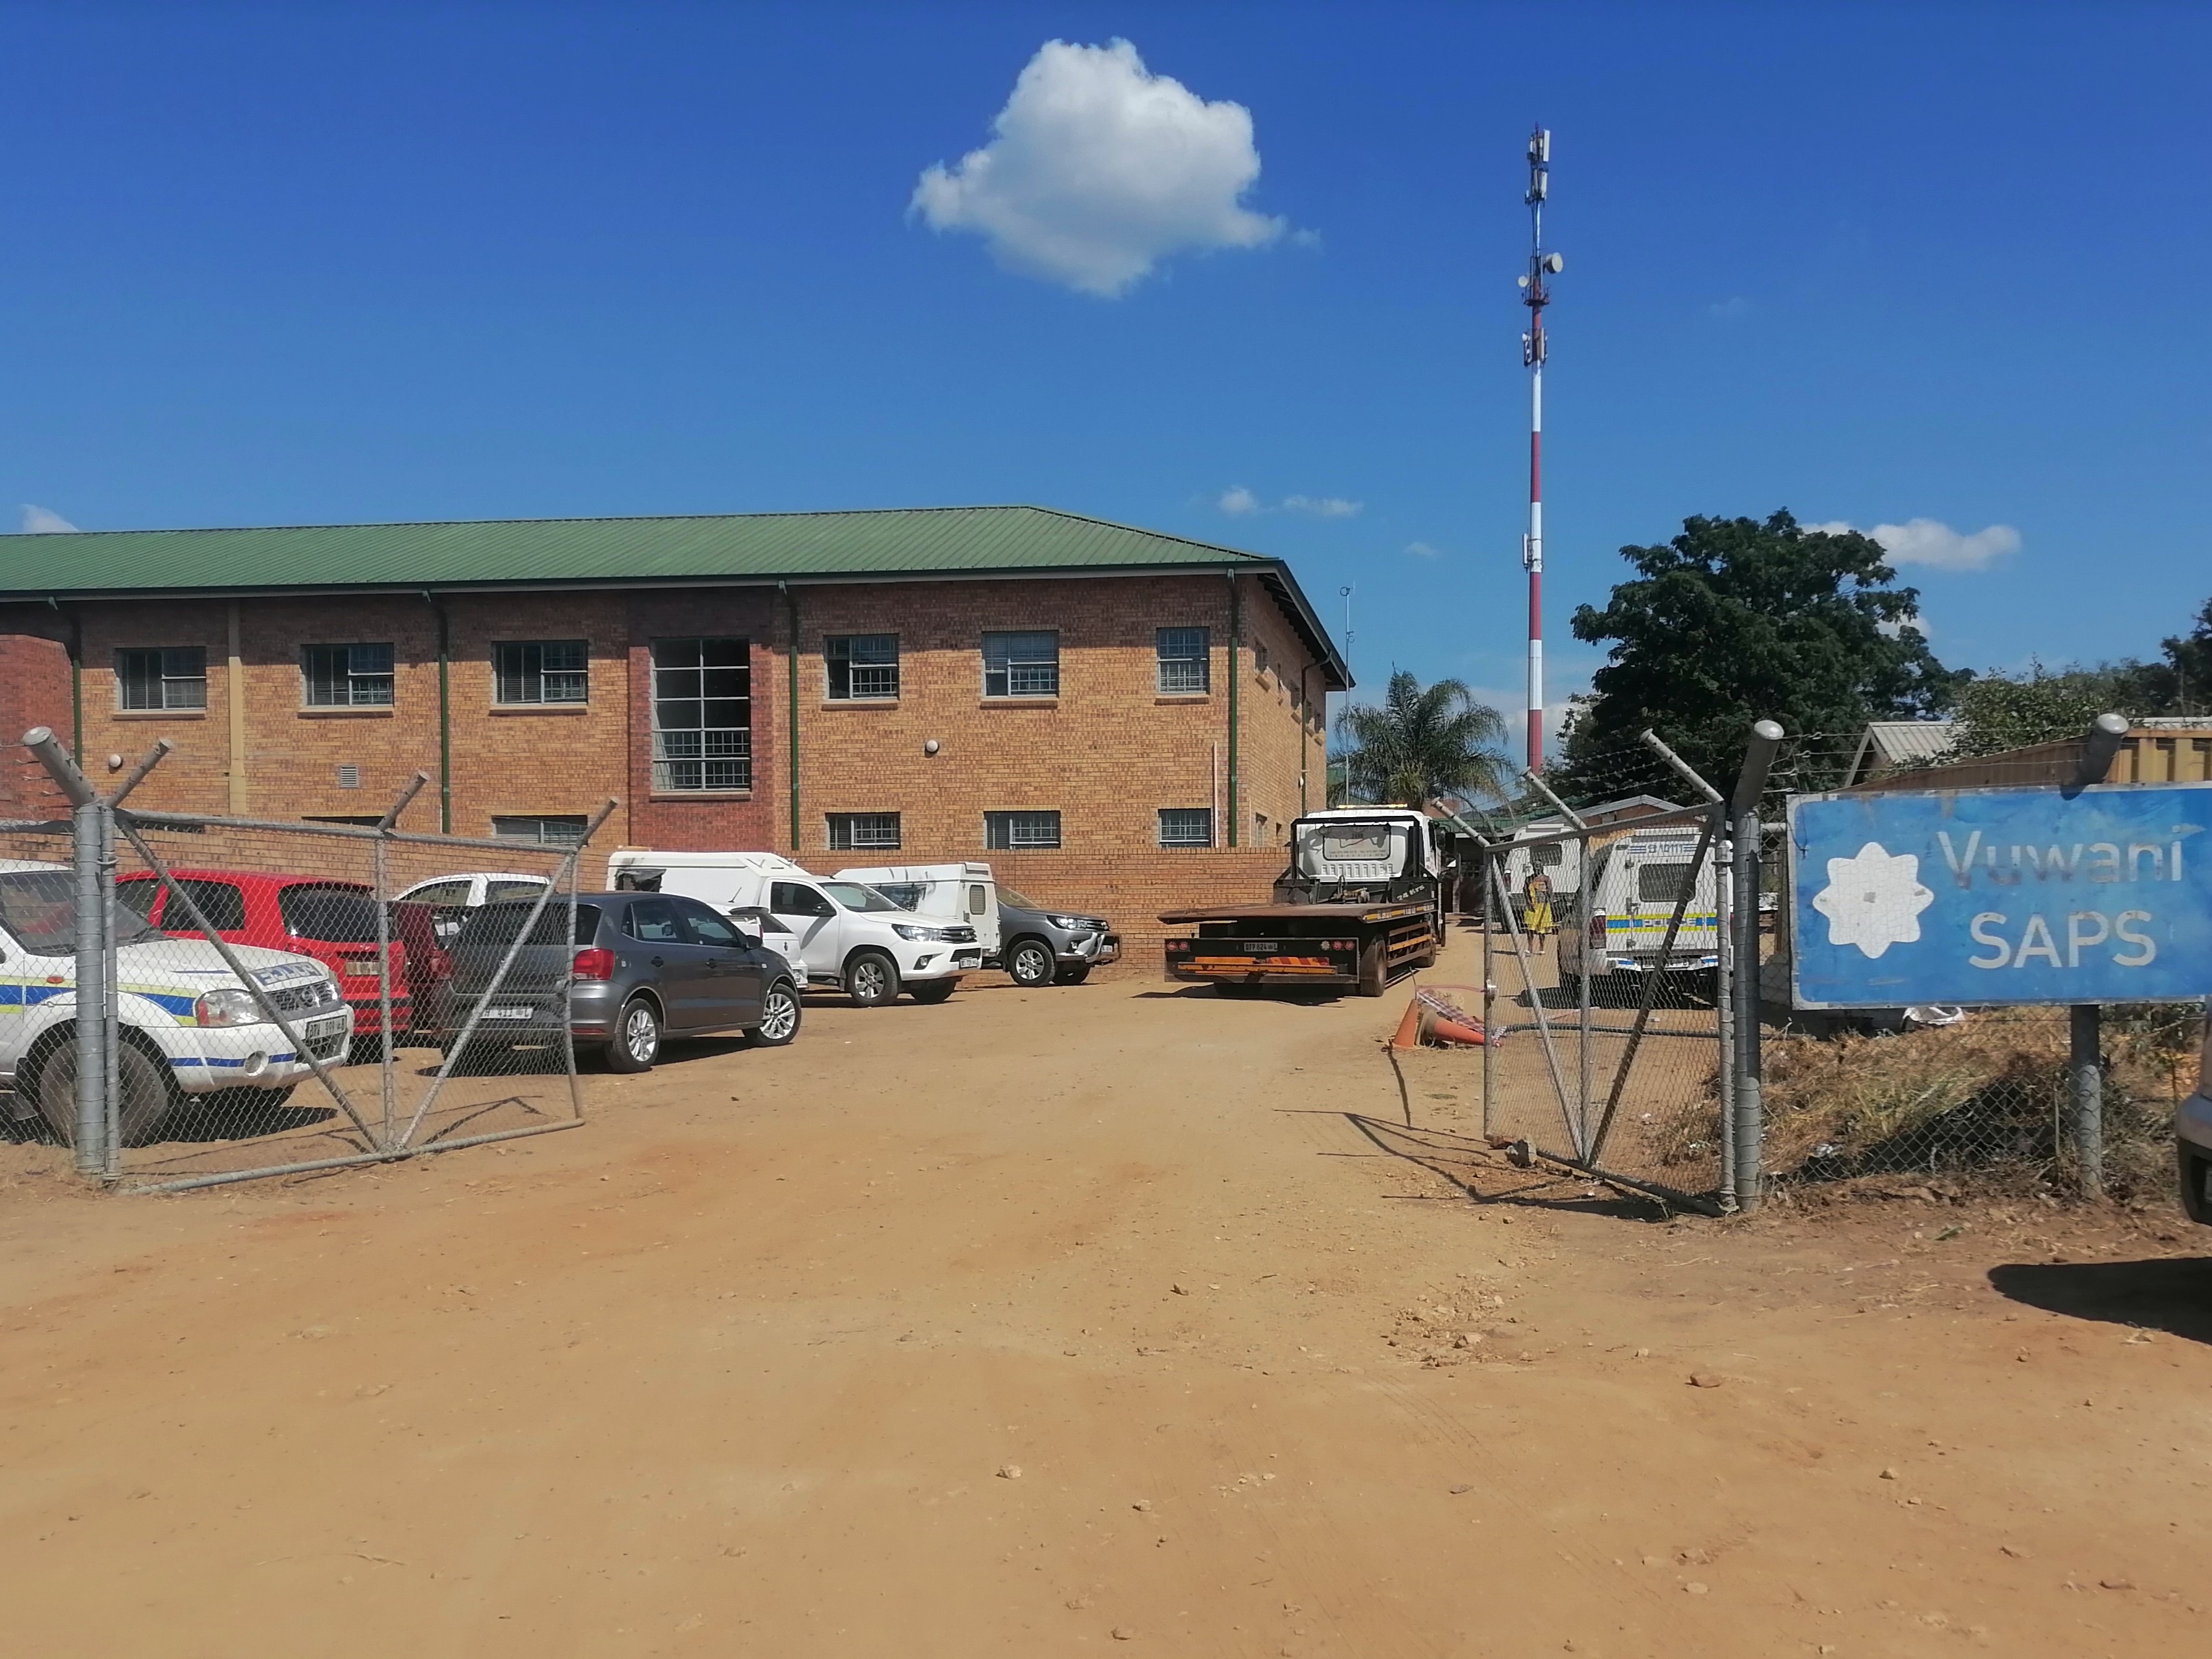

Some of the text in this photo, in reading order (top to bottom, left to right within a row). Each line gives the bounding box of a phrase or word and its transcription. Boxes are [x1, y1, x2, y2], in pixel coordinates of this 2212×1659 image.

[1937, 825, 2183, 889] Vuwani
[1396, 892, 1409, 901] 24
[1643, 919, 1695, 928] POLCE
[1968, 910, 2157, 969] SAPS
